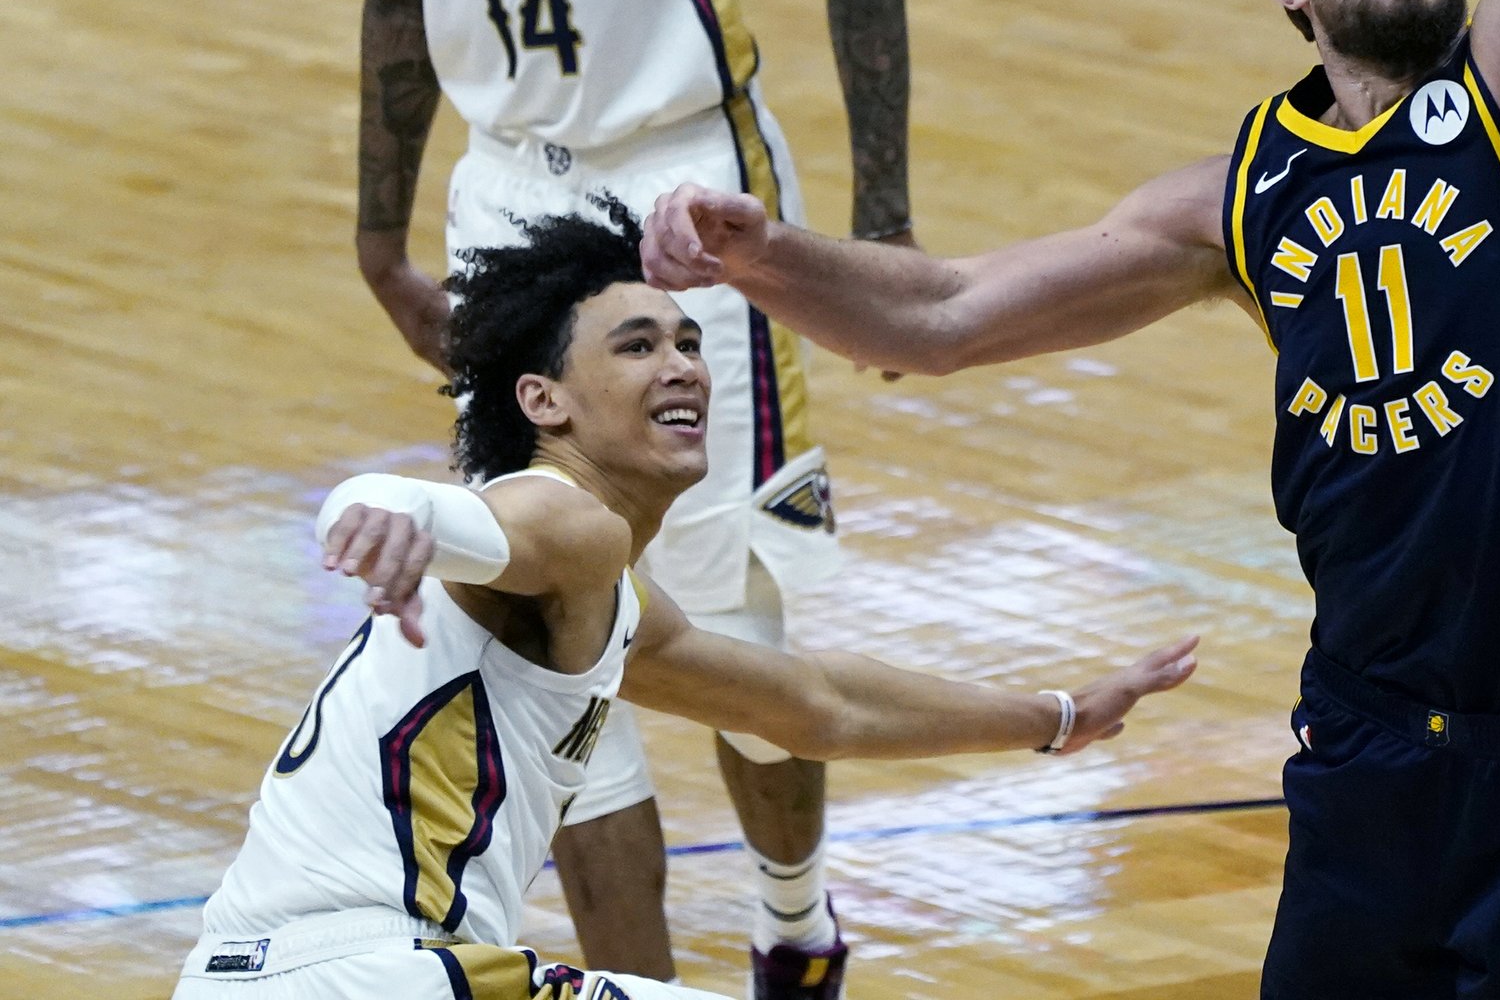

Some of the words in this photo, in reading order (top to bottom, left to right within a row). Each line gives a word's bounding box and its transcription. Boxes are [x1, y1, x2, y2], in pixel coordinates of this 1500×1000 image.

[1270, 168, 1494, 309] INDIANA
[1335, 243, 1415, 383] 11
[1287, 350, 1495, 455] PACERS
